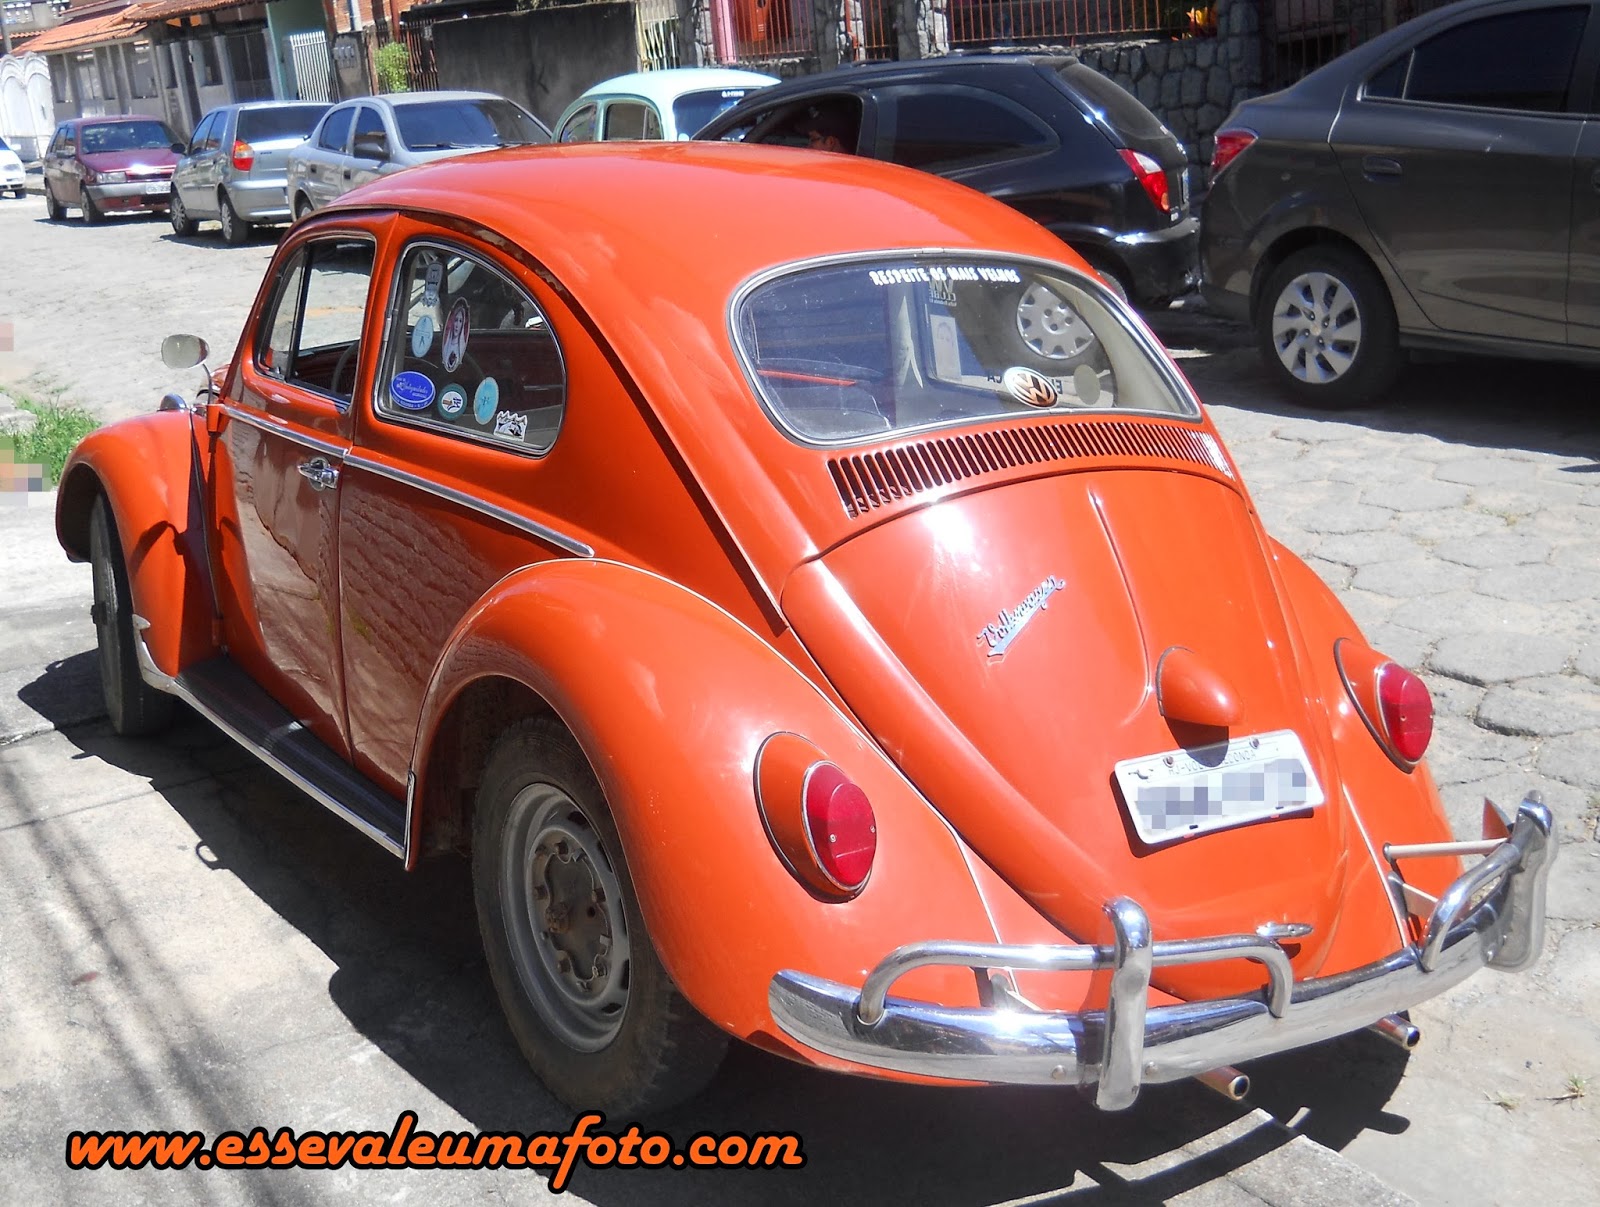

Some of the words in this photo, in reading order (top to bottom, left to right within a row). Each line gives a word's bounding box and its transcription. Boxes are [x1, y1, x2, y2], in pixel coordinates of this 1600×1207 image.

[869, 267, 929, 286] RESPEITE
[930, 267, 947, 281] OS
[947, 266, 979, 281] MAIS
[977, 267, 1021, 283] VELHOS
